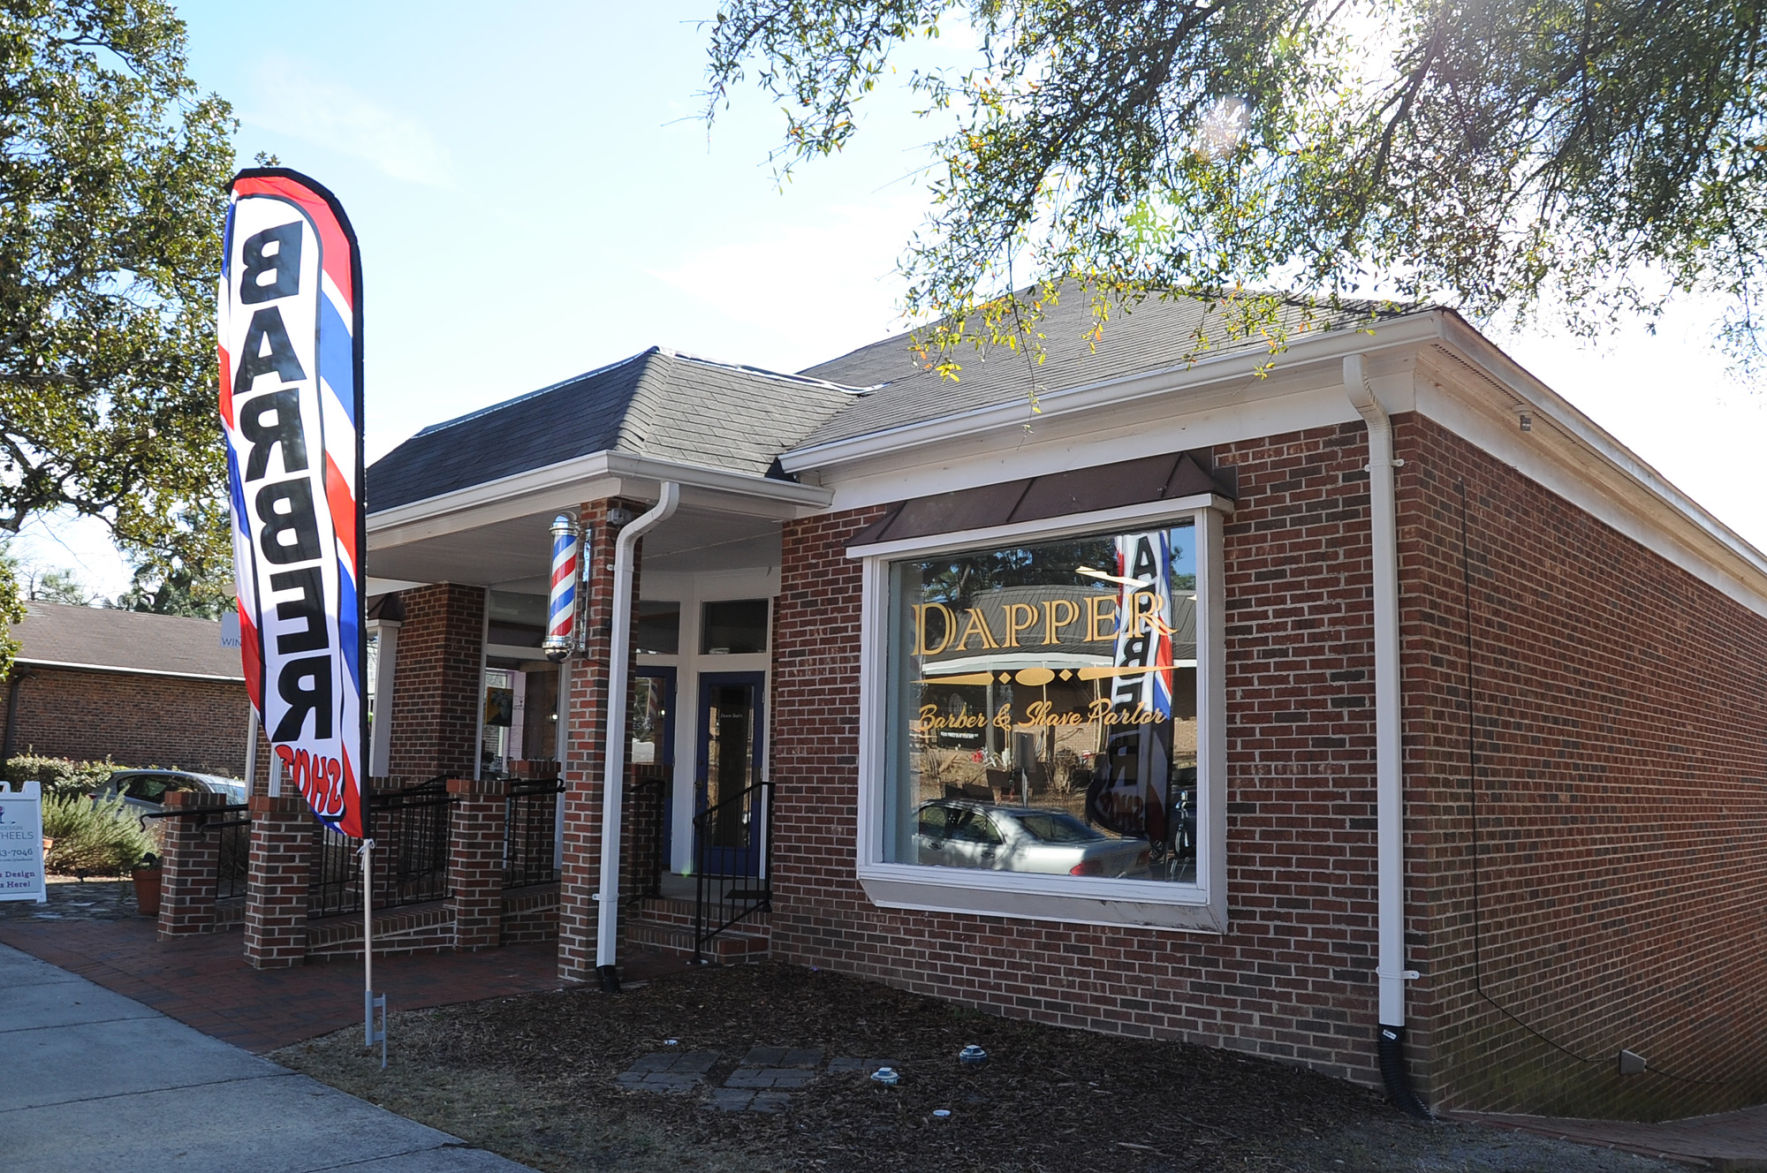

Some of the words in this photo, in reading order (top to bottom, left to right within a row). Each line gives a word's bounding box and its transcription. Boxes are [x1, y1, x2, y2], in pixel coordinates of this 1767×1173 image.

[911, 591, 1178, 656] DAPPER
[919, 703, 988, 731] Barber
[992, 703, 1012, 731] &
[1018, 700, 1083, 728] Shave
[1087, 697, 1167, 727] Parlor
[0, 831, 34, 840] HEELS
[0, 848, 33, 857] 3-7046
[5, 870, 36, 879] Design
